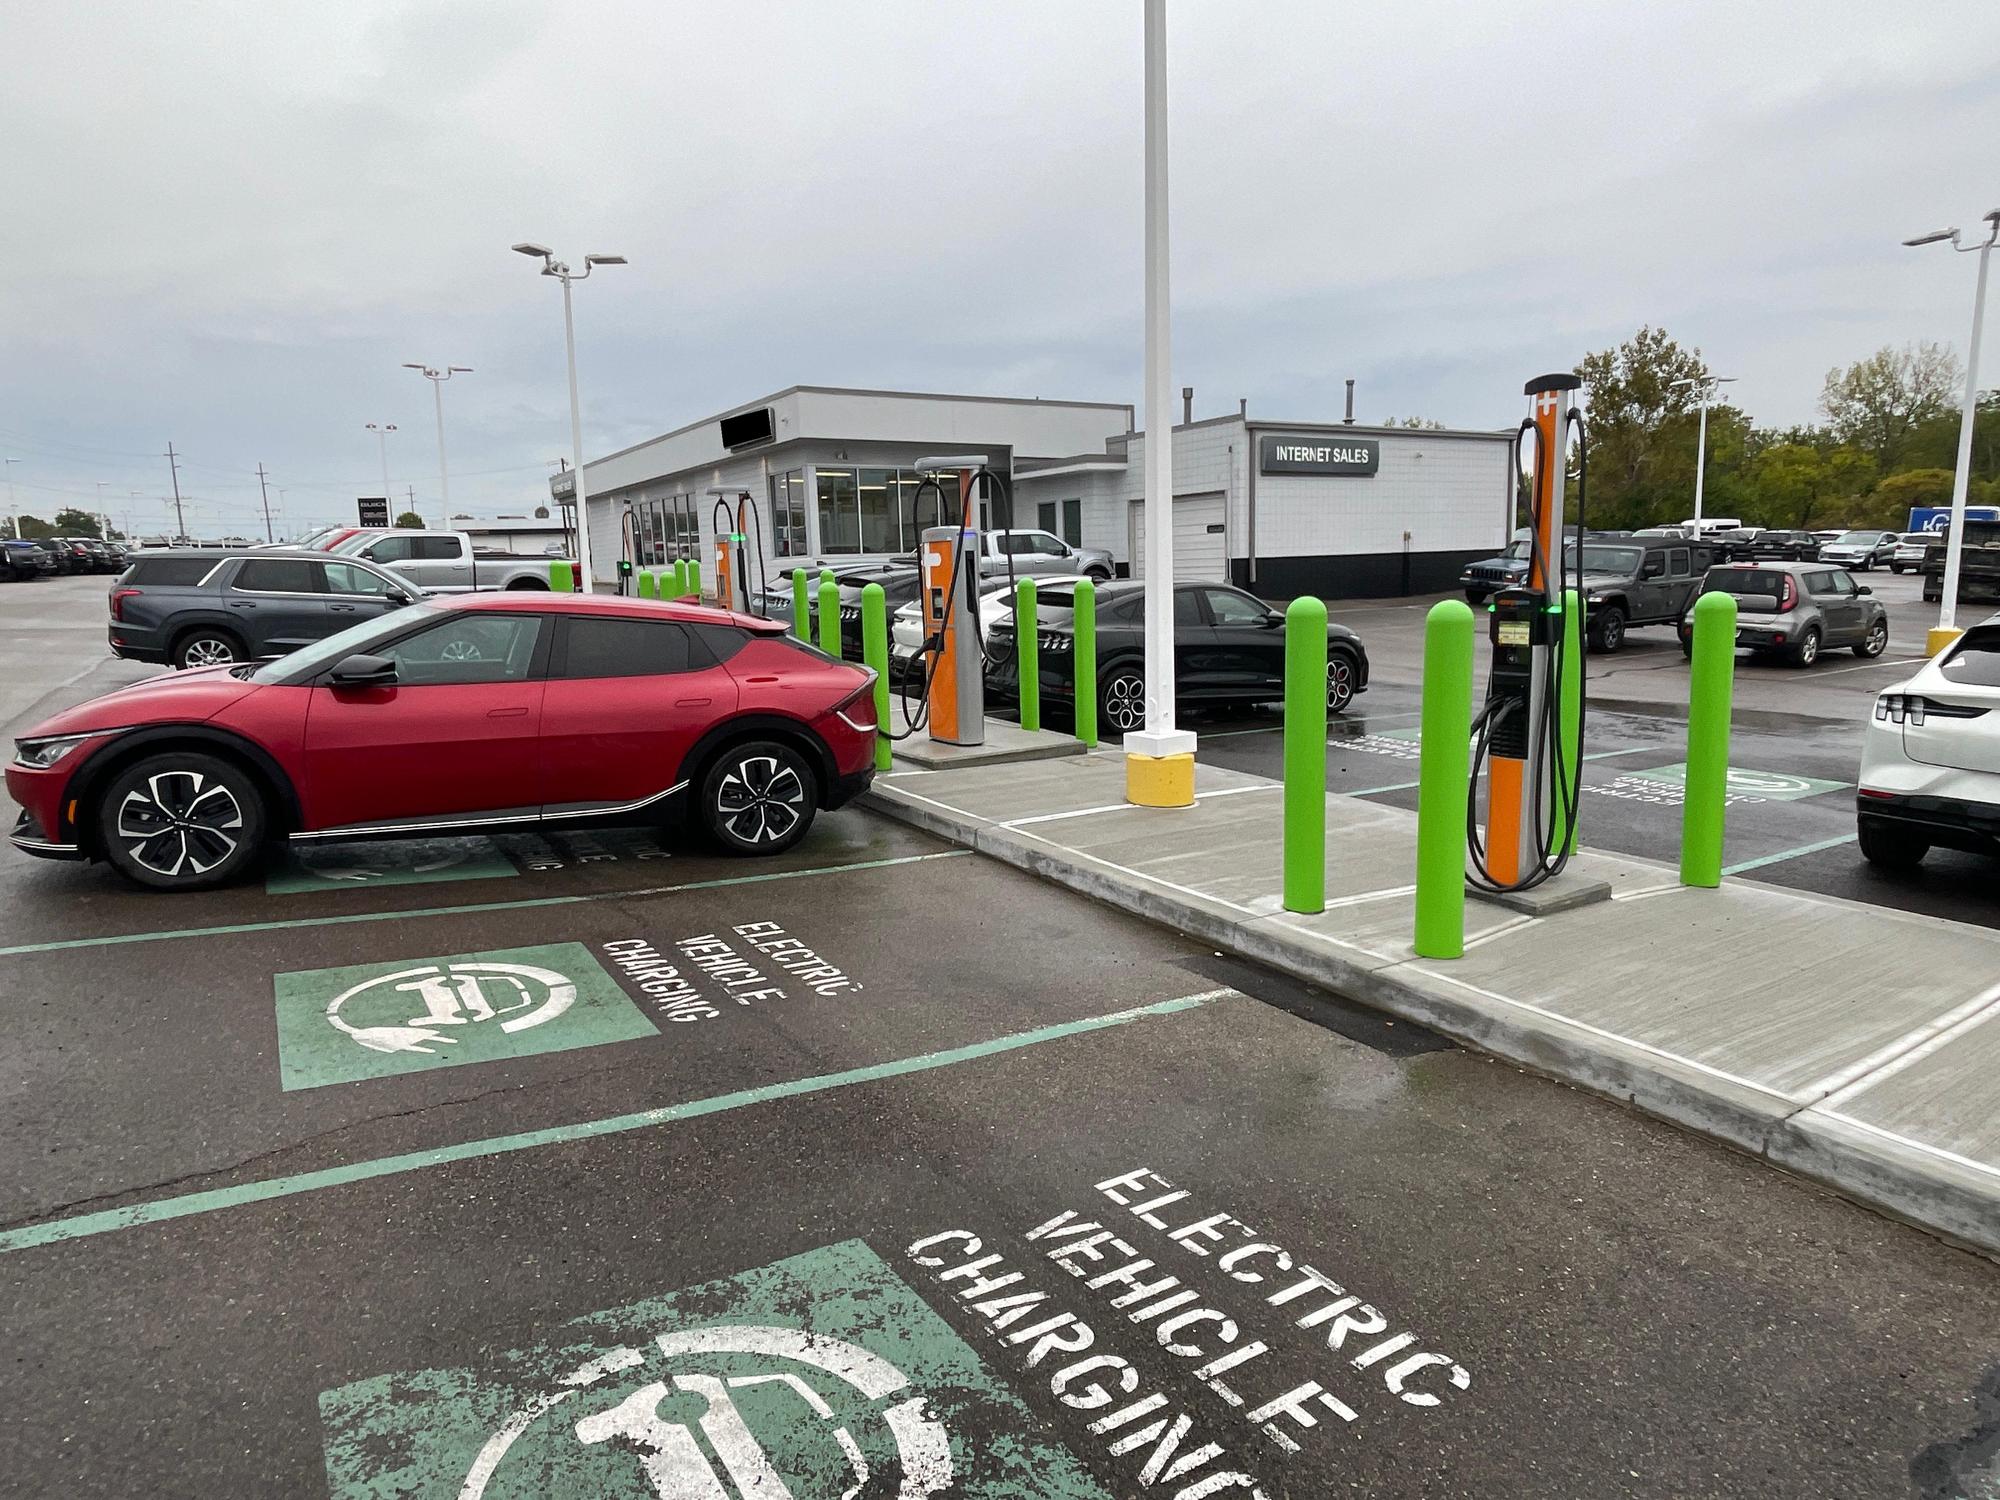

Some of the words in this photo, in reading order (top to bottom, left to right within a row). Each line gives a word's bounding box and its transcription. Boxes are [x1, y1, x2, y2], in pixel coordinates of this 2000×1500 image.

[1276, 446, 1331, 462] INTERNET
[1333, 448, 1369, 464] SALES
[602, 938, 720, 1022] CHARGING
[675, 934, 787, 1006] VEHICLE
[1094, 1167, 1471, 1407] ELECTRIC
[1025, 1209, 1359, 1454] VEHICLE
